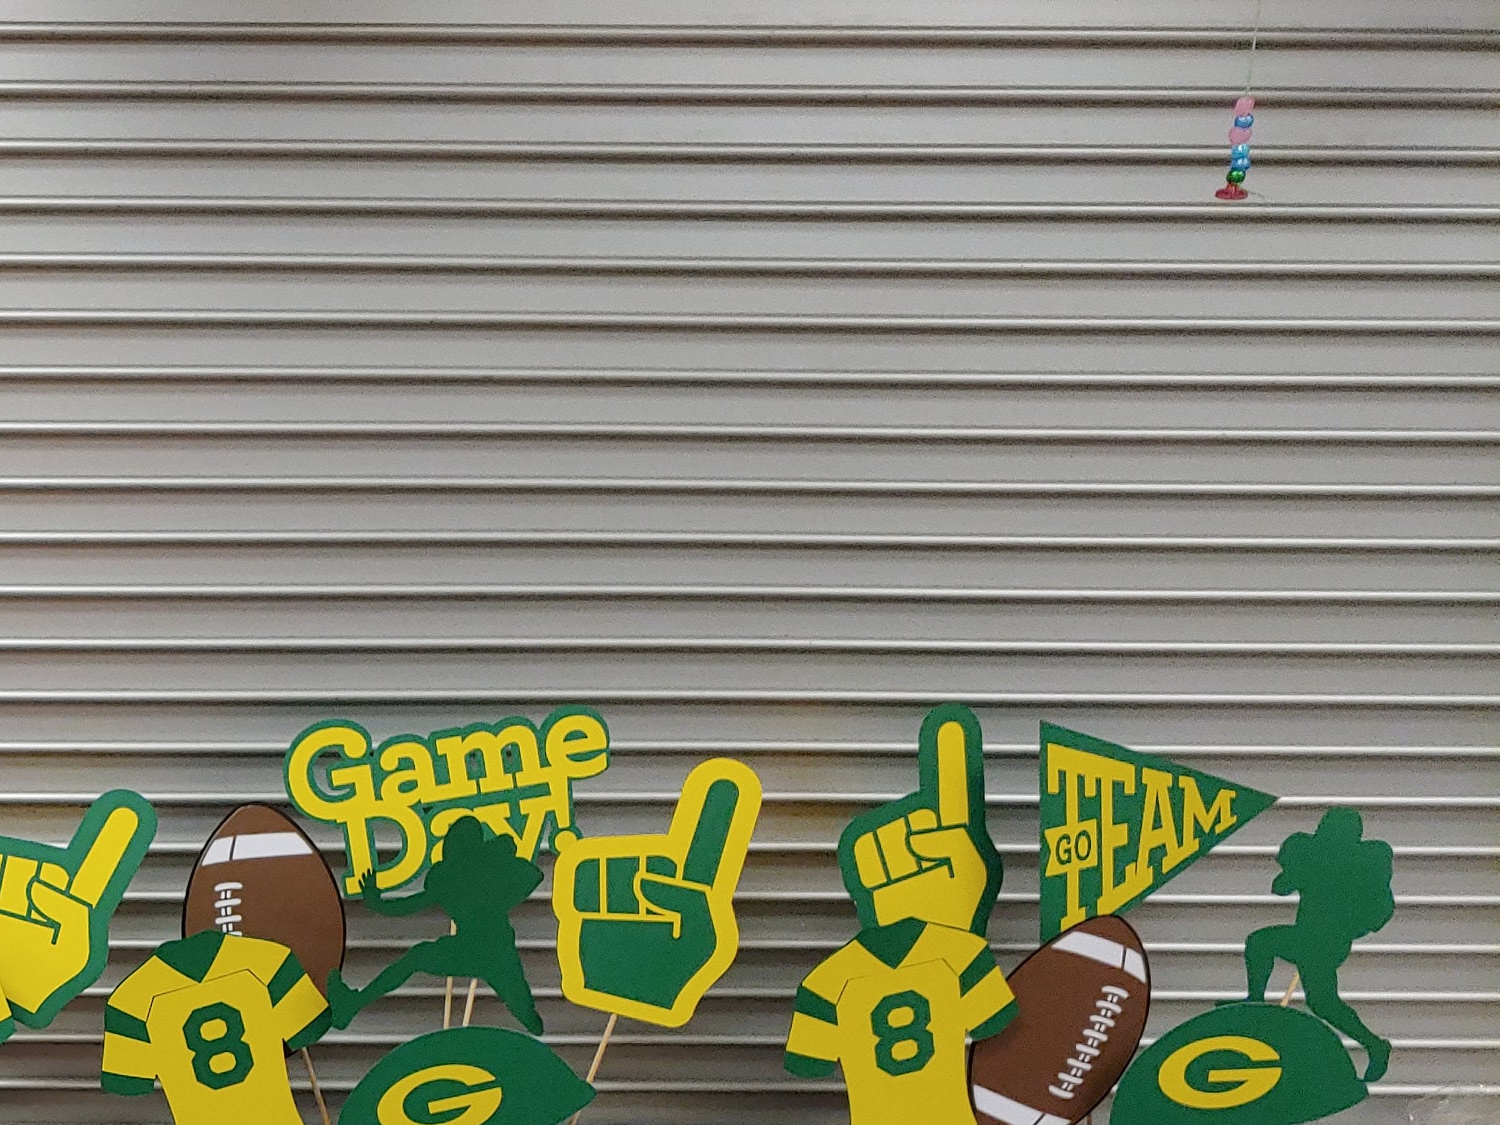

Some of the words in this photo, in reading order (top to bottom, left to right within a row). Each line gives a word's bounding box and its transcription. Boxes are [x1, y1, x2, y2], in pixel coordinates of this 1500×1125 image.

[288, 714, 607, 821] Game
[1046, 743, 1237, 932] TEAM
[1055, 829, 1092, 866] GO
[183, 1002, 254, 1090] 8
[871, 991, 934, 1076] 8
[1158, 1035, 1282, 1109] G
